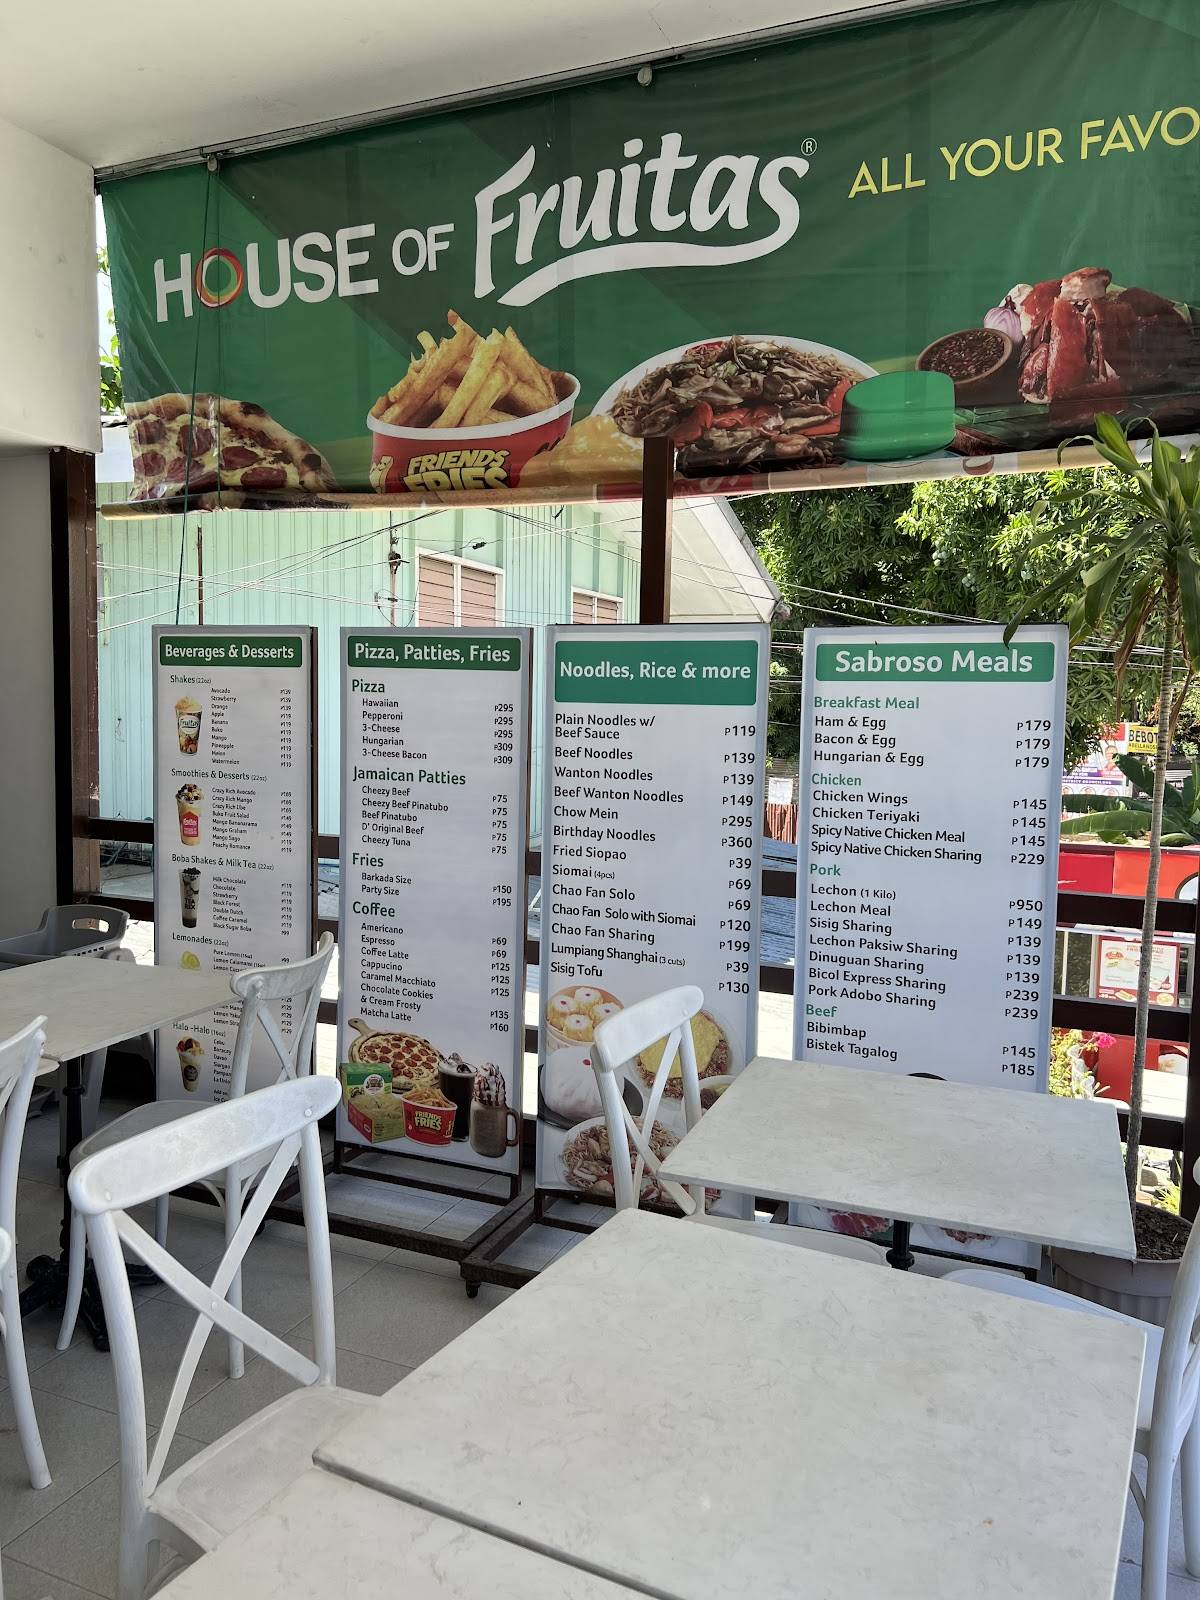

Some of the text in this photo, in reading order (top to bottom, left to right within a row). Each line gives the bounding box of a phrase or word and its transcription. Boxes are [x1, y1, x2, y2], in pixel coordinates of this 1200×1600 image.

[848, 106, 1200, 198] ALL YOUR FAVO
[154, 132, 810, 322] HOUSE OF Fruitas
[408, 450, 510, 474] FRIENDS
[165, 644, 294, 661] Beverages & Desserts
[355, 643, 510, 664] Pizza, Patties, Fries
[836, 649, 1033, 672] Sabroso Meals
[561, 661, 751, 681] Noodles, Rice & more
[170, 675, 195, 684] Shakes
[352, 679, 385, 693] Pizza
[362, 698, 399, 708] Hawaiian
[814, 696, 919, 709] Breakfast Meal
[362, 710, 403, 722] Pepperoni
[555, 713, 656, 727] Plain Noodles w/
[815, 716, 886, 731] Ham Egg
[362, 723, 400, 733] 3-Cheese
[555, 726, 620, 740] Beef Sauce
[362, 736, 404, 747] Hungarian
[815, 733, 896, 749] Bacon Egg
[362, 748, 427, 759] 3-Cheese Bacon
[555, 746, 633, 760] Beef Noodles
[814, 750, 924, 767] Hungarian Egg
[171, 768, 250, 780] Smoothies & Desserts
[352, 766, 466, 785] Jamaican Patties
[554, 766, 653, 781] Wanton Noodles
[811, 773, 862, 786] Chicken
[362, 785, 410, 797] Cheezy Beef
[554, 786, 684, 803] Beef Wanton Noodles
[813, 790, 908, 807] Chicken Wings
[362, 798, 449, 812] Cheezy Beef Pinatubo
[554, 806, 618, 819] Chow Mein
[812, 807, 920, 824] Chicken Teriyaki
[554, 825, 656, 842] Birthday Noodles
[812, 824, 965, 843] Spicy Native Chicken Meal
[353, 853, 384, 867] Fries
[553, 845, 627, 862] Fried Siopao
[811, 841, 982, 865] Spicy Native Chicken Sharing
[172, 854, 256, 869] Boba Shakes & Milk Tea
[810, 863, 841, 876] Pork
[362, 872, 412, 884] Barkada Size
[552, 864, 592, 877] Siomai
[552, 884, 635, 901] Chao Fan Solo
[811, 883, 857, 896] Lechon
[353, 901, 395, 917] Coffee
[552, 903, 696, 926] Chao Fan Solo with Siomai
[811, 900, 891, 917] Lechon Meal
[361, 922, 404, 934] Americano
[552, 923, 655, 946] Chao Fan Sharing
[810, 917, 892, 937] Sisig Sharing
[172, 932, 213, 945] Lemonades
[361, 934, 395, 946] Espresso
[551, 942, 605, 961] Lumpiang
[607, 947, 658, 964] Shanghai
[810, 934, 958, 960] Lechon Paksiw Sharing
[361, 959, 403, 971] Cappucino
[551, 962, 603, 977] Sisig Tofu
[809, 951, 924, 974] Dinuguan Sharing
[361, 971, 436, 988] Caramel Macchiato
[809, 968, 946, 994] Bicol Express Sharing
[361, 983, 434, 1000] Chocolate Cookies
[809, 984, 936, 1011] Pork Adobo Sharing
[369, 996, 421, 1012] Cream Frosty
[806, 1004, 838, 1017] Beef
[807, 1021, 866, 1040] Bibimbap
[807, 1038, 897, 1062] Bistek Tagalog
